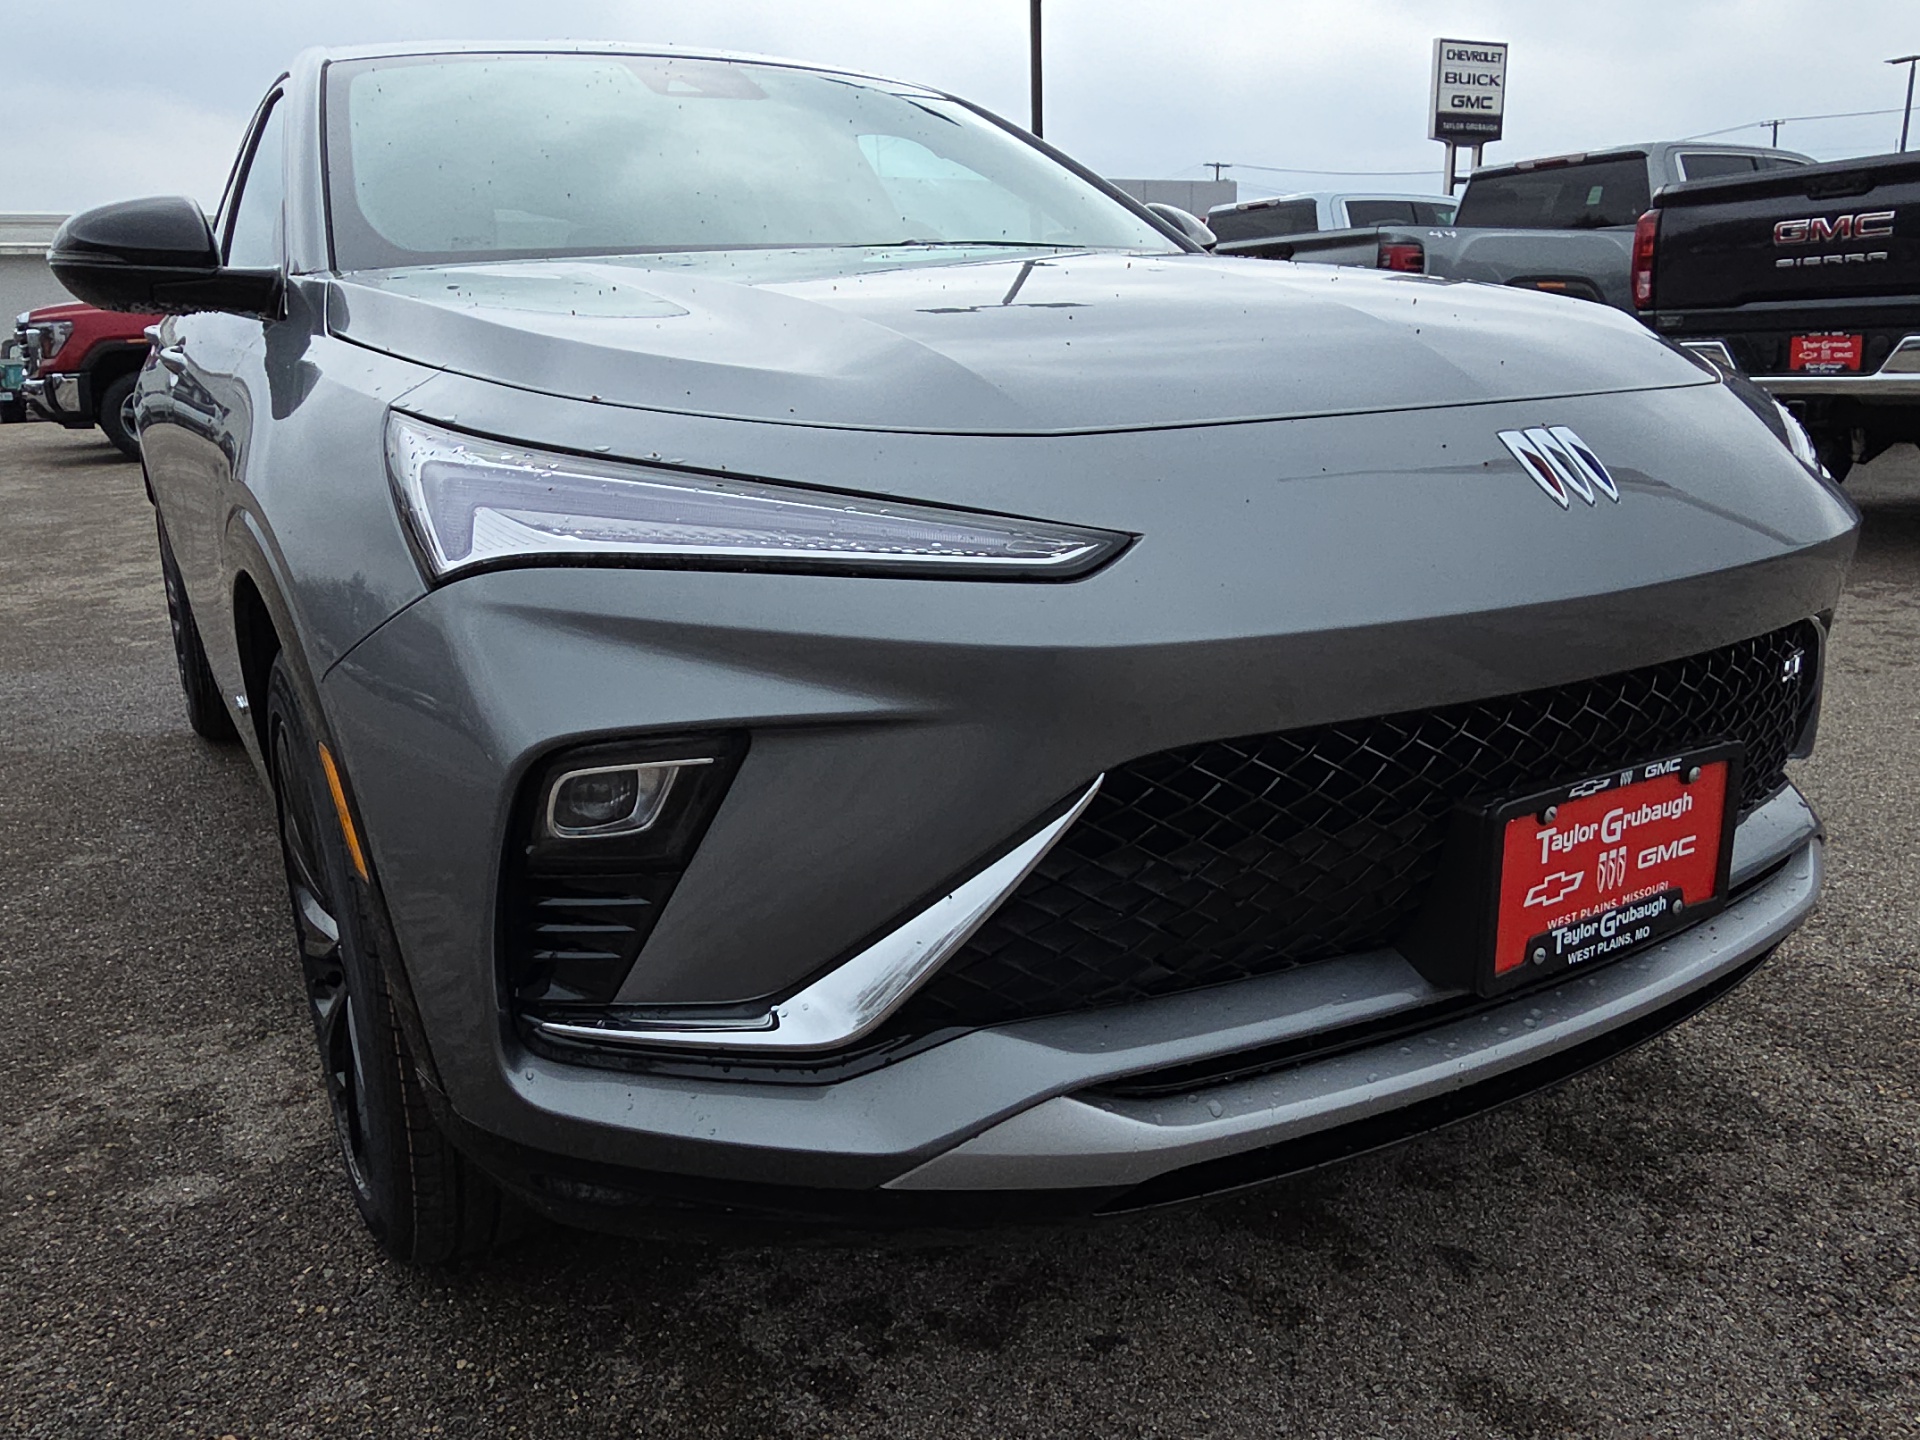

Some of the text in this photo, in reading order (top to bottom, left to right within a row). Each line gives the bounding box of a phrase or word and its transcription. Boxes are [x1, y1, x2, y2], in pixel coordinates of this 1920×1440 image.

[1446, 49, 1502, 63] CHEVROLET
[1444, 72, 1501, 87] BUICK
[1451, 95, 1493, 109] GMC
[1443, 122, 1464, 130] TAYLOR
[1774, 211, 1895, 245] GMC
[1775, 252, 1888, 267] SIERRA
[1644, 758, 1682, 779] GMC
[1536, 792, 1693, 865] Taylor Grubaugh
[1637, 835, 1697, 870] GMC
[1547, 912, 1577, 930] WEST
[1622, 881, 1669, 905] MISSOURI
[1552, 896, 1666, 955] Taylor Grubaugh
[1567, 926, 1650, 965] WEST PLAINS, MO
